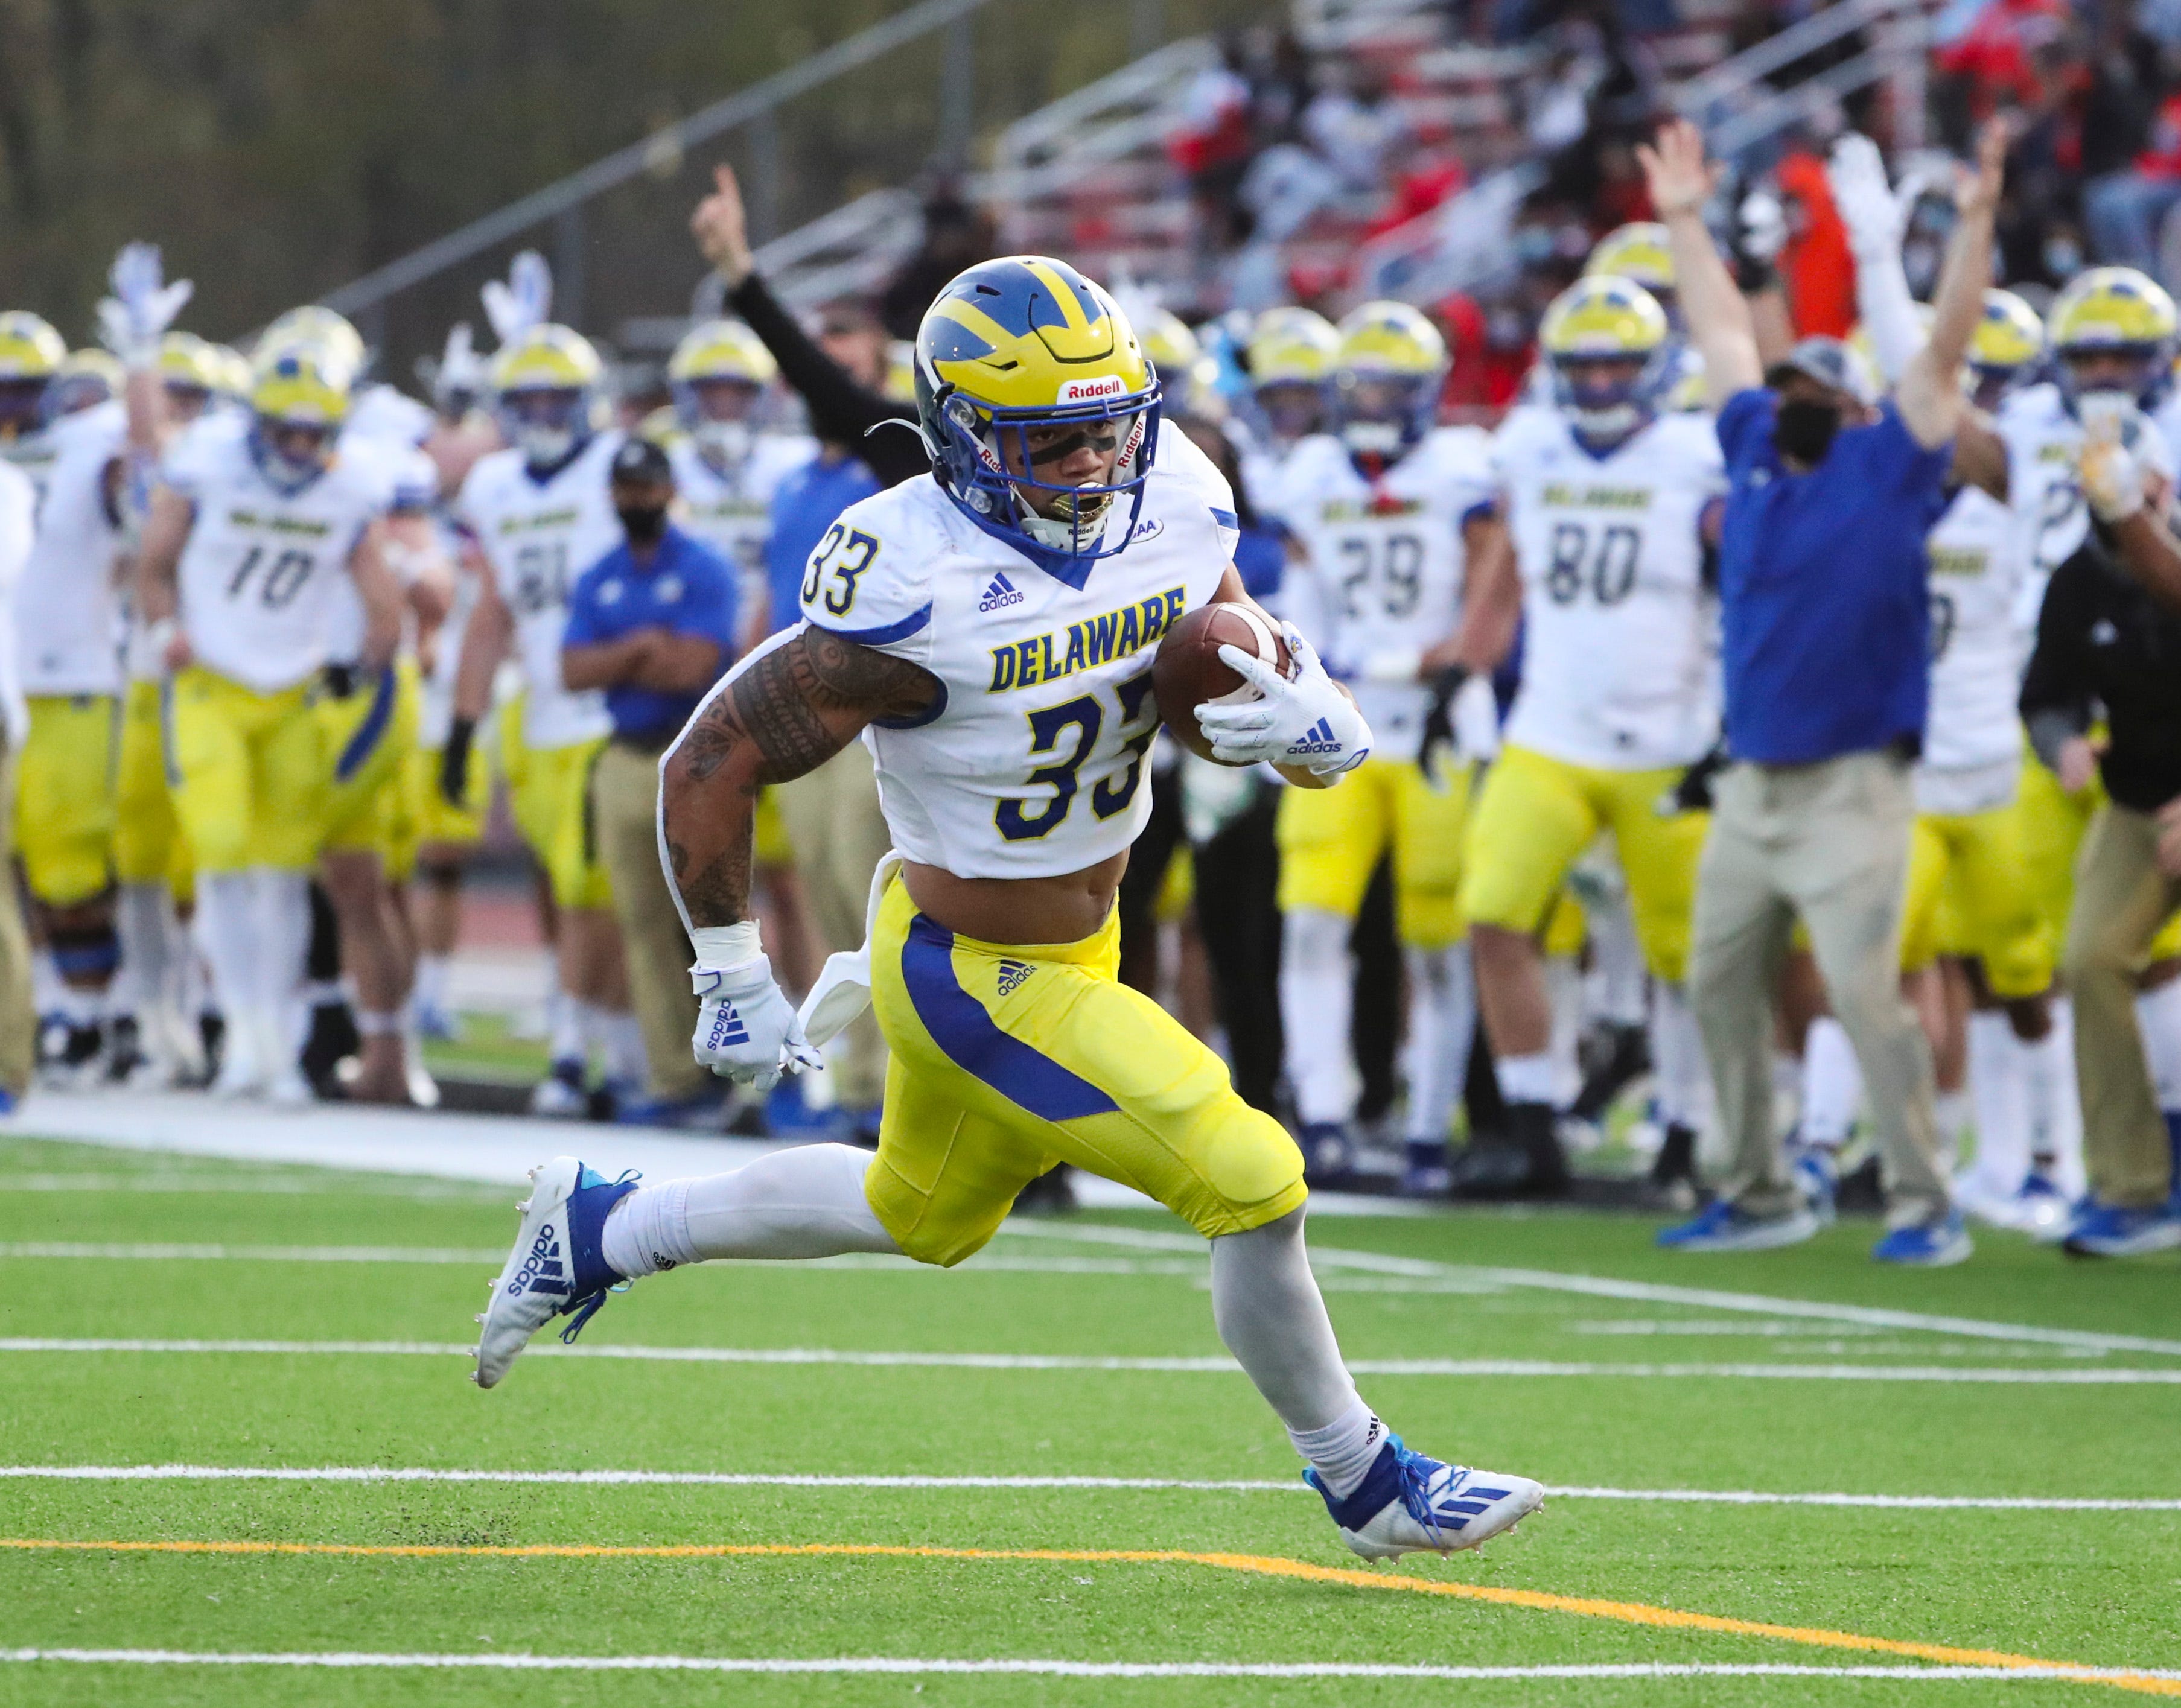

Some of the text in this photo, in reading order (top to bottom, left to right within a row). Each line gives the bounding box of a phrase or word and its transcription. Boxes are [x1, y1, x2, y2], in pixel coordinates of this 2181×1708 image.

[1069, 380, 1120, 398] Riddell
[1117, 421, 1143, 468] Riddell
[1068, 526, 1094, 535] Rddell
[1129, 519, 1156, 539] AA
[228, 545, 315, 609] 10
[803, 522, 882, 618] 33
[1340, 533, 1425, 618] 29
[1545, 523, 1641, 606] 80
[979, 591, 1024, 612] adidas
[986, 584, 1186, 694] DELAWARE
[993, 668, 1162, 843] 33
[1287, 742, 1342, 754] adidas
[707, 999, 731, 1050] adidas
[508, 1224, 555, 1297] adidas
